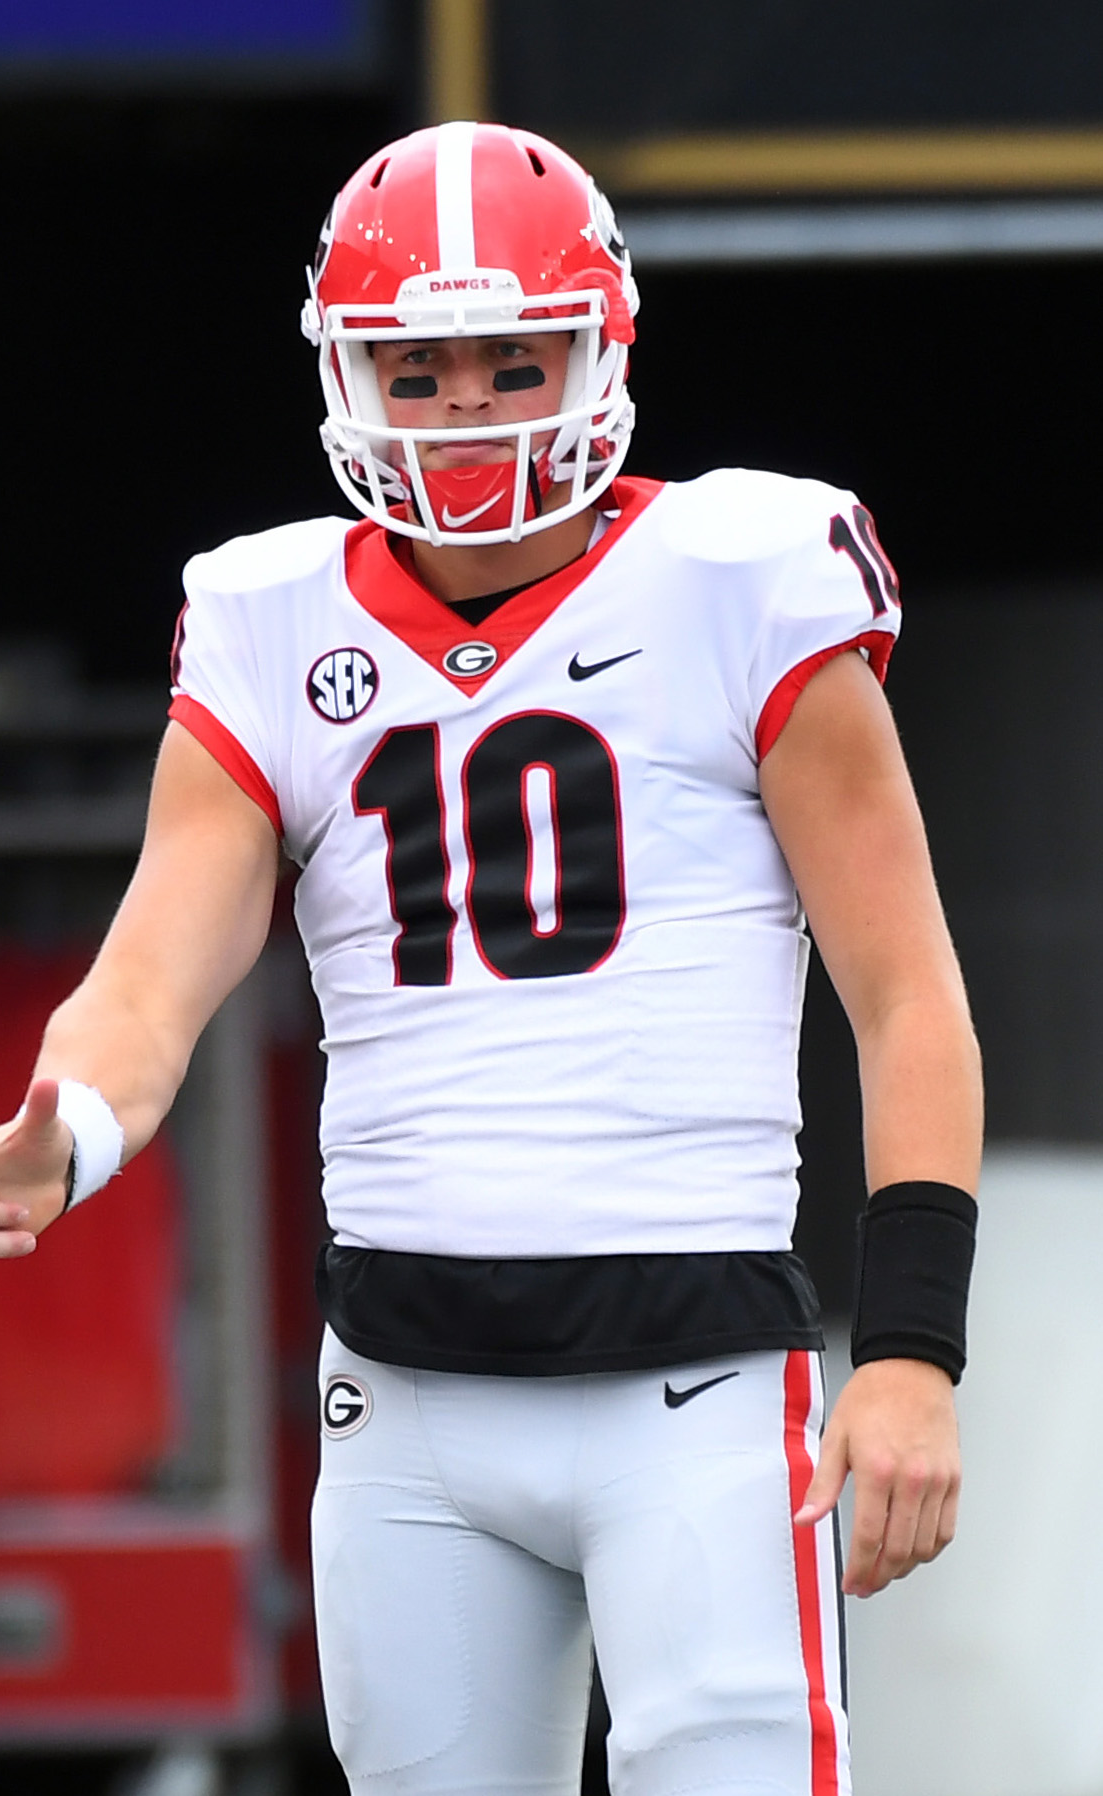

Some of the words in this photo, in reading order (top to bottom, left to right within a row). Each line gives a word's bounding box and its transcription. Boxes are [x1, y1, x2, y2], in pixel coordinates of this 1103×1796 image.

[429, 278, 490, 292] DAWGS
[311, 650, 375, 721] SEC
[352, 709, 626, 987] 10
[324, 1381, 365, 1429] G
